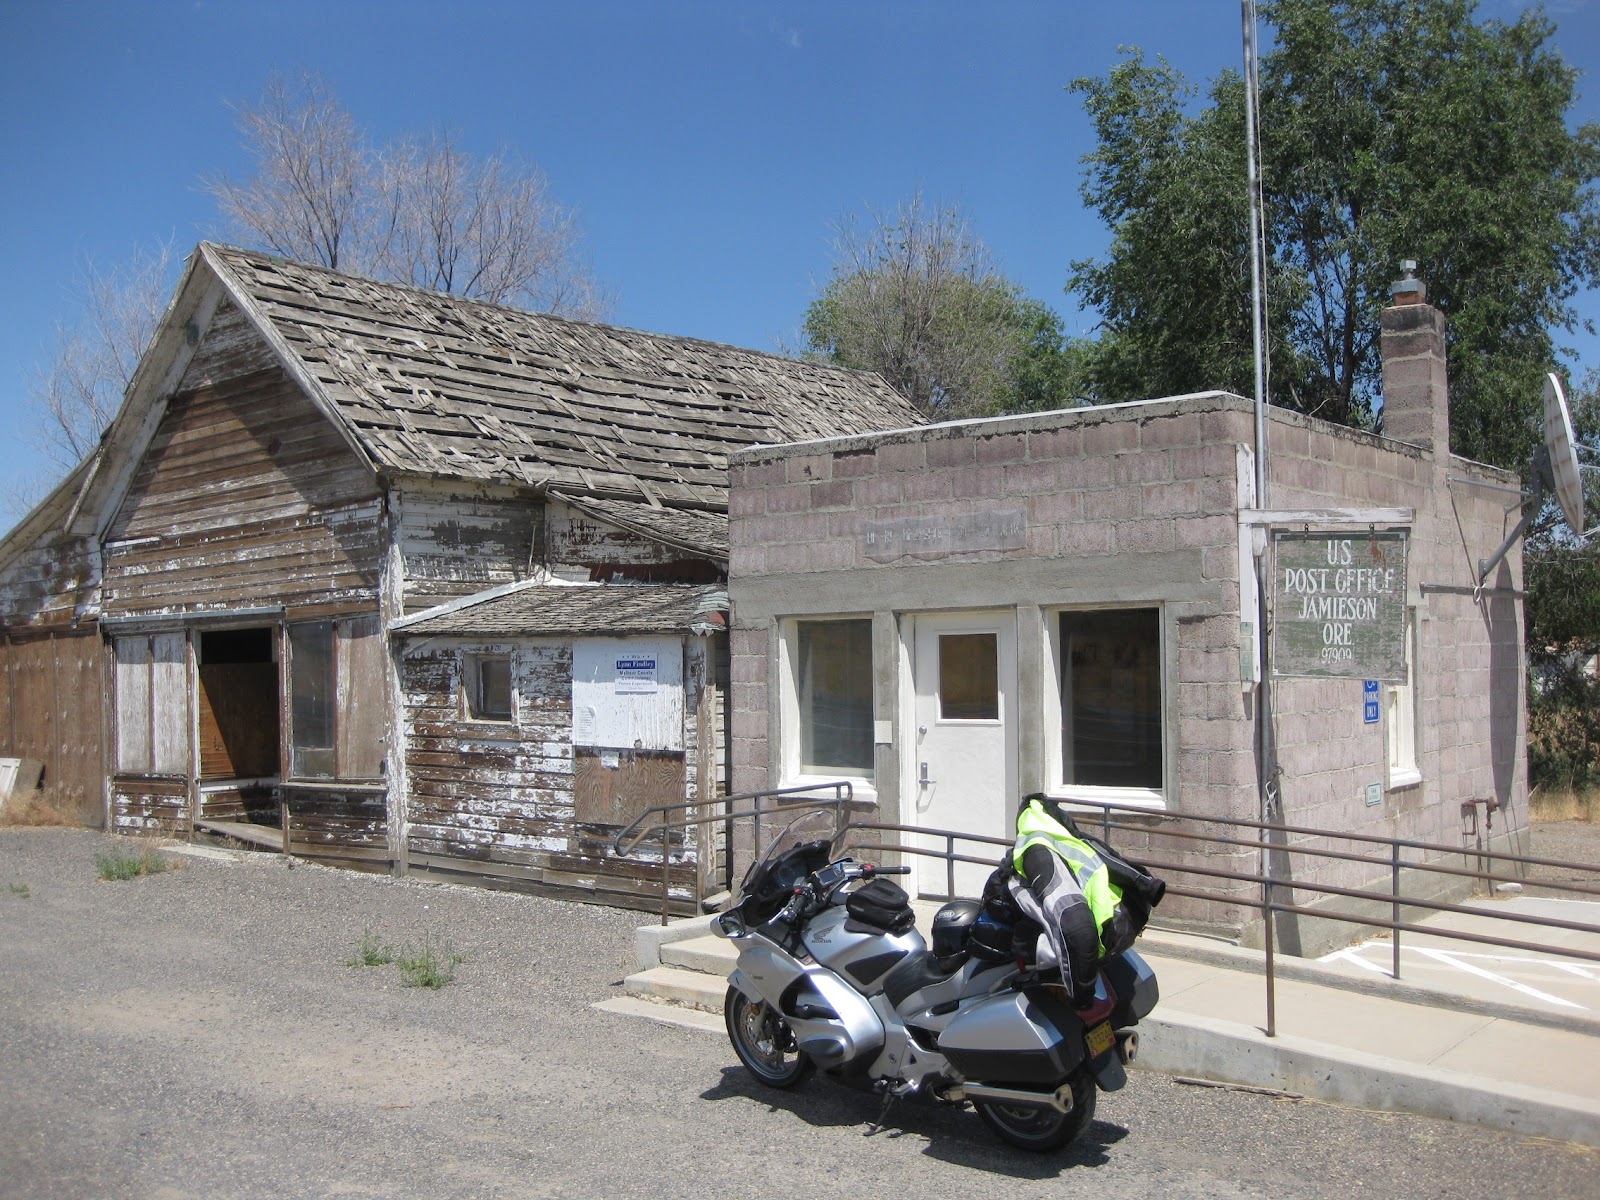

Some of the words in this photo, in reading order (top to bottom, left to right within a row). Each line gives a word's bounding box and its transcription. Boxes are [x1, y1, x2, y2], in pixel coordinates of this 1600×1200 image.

[1285, 568, 1329, 594] POST
[1335, 568, 1394, 594] OFFICE
[1299, 597, 1377, 620] JAMIESON
[1323, 623, 1355, 646] ORE.
[618, 661, 632, 669] Lynn
[632, 661, 653, 669] Findley
